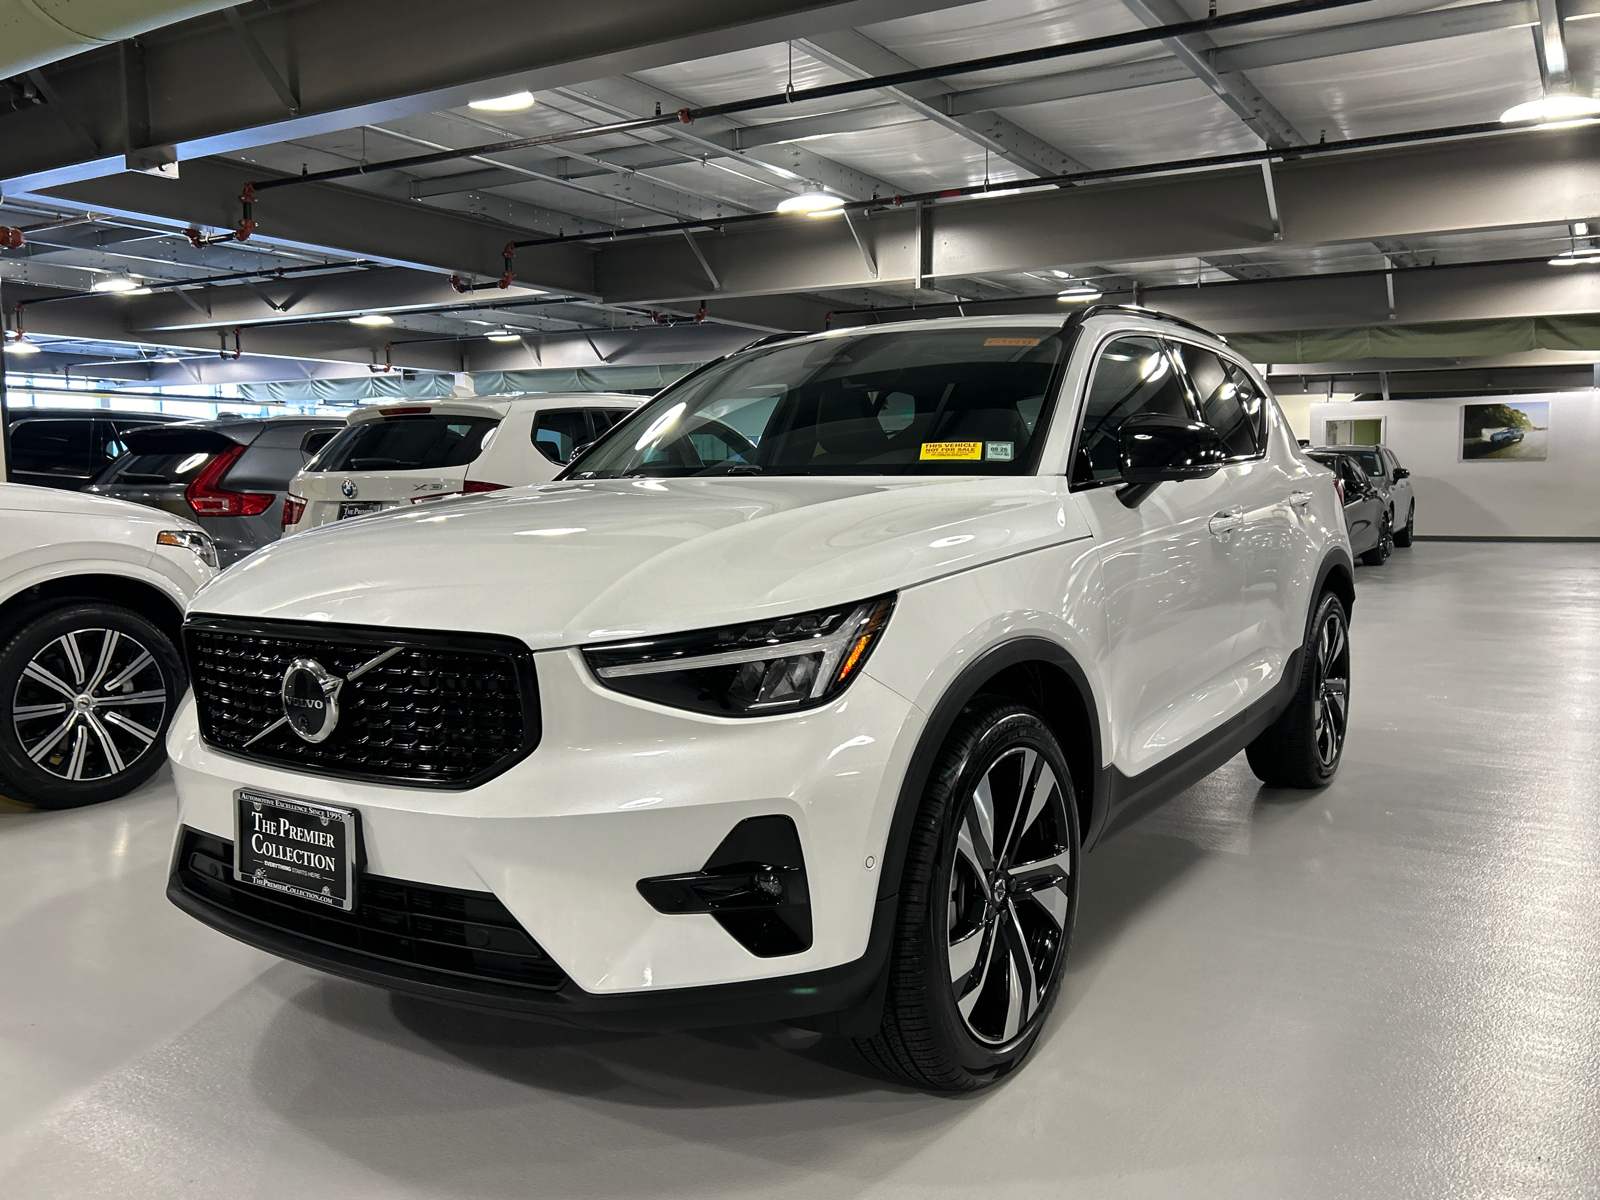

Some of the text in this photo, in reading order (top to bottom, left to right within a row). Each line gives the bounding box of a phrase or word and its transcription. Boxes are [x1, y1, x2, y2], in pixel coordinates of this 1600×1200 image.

[284, 695, 324, 709] VOLVO
[326, 810, 342, 821] 1995
[251, 811, 335, 849] THE PREMIER
[251, 833, 336, 872] COLLECTION
[264, 860, 292, 872] EVERYTHING
